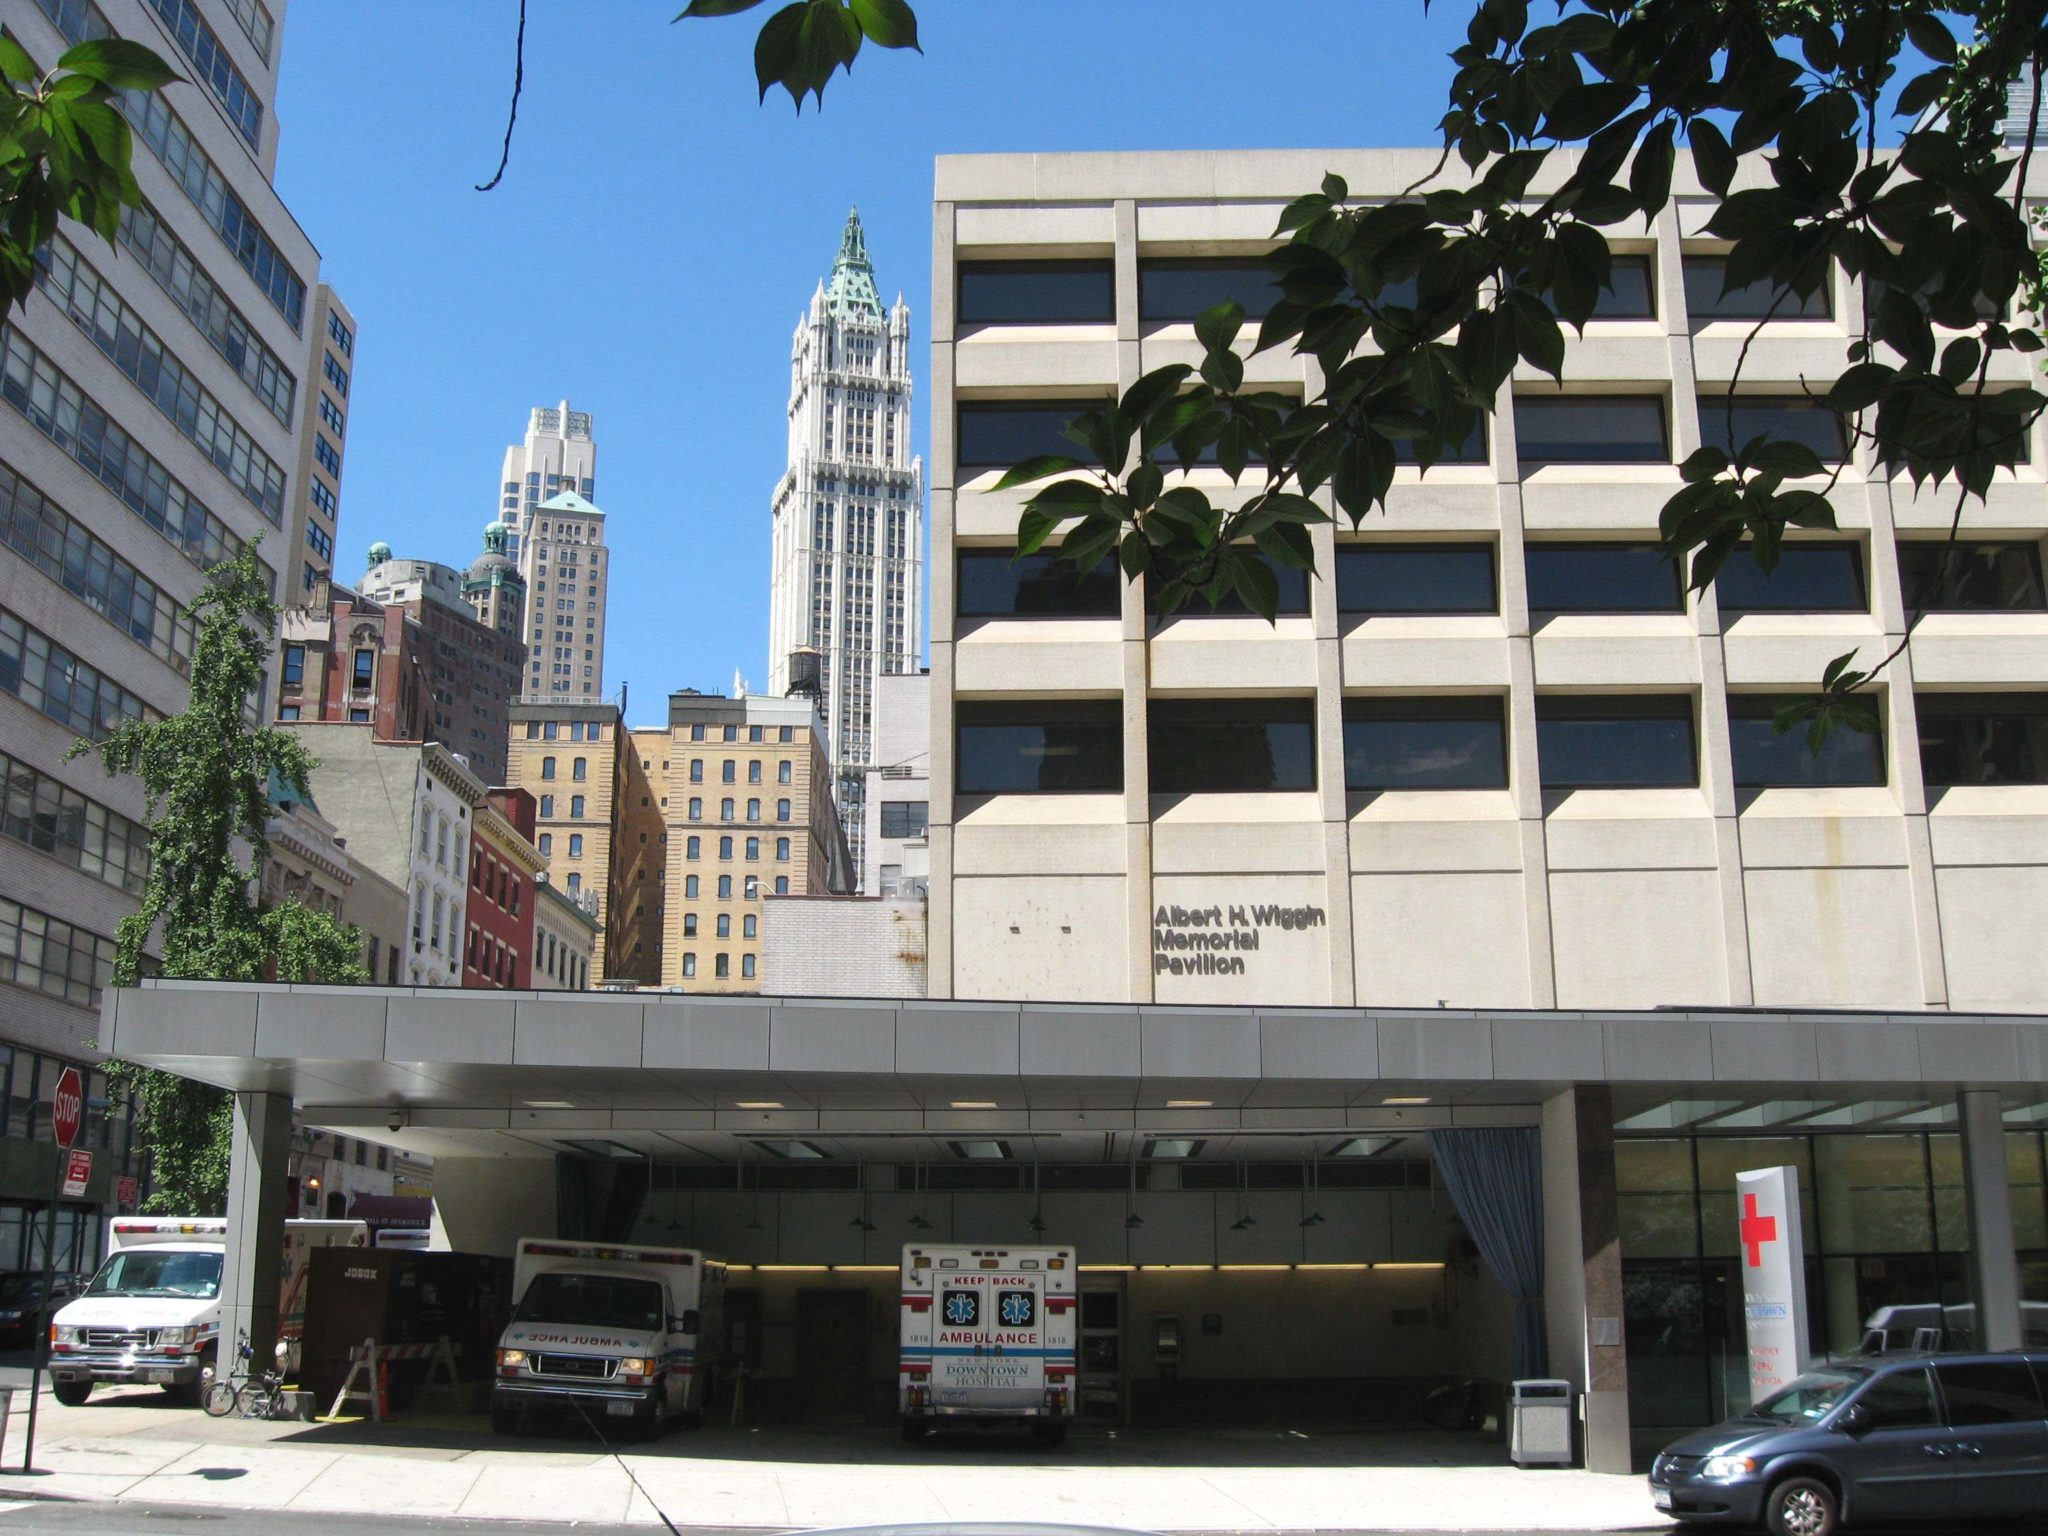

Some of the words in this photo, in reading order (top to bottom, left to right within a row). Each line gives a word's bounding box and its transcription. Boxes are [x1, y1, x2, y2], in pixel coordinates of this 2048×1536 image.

[1155, 905, 1223, 927] Albert
[1251, 904, 1326, 930] Wiggin
[1154, 929, 1259, 951] Memorial
[1155, 953, 1245, 975] Pavilion
[56, 1092, 80, 1123] STOP
[954, 1276, 985, 1285] KEEP
[993, 1277, 1026, 1286] BACK
[939, 1332, 1037, 1344] AMBULANCE
[946, 1365, 1029, 1376] DOWNTOWN
[956, 1377, 1020, 1388] HOSPITAL
